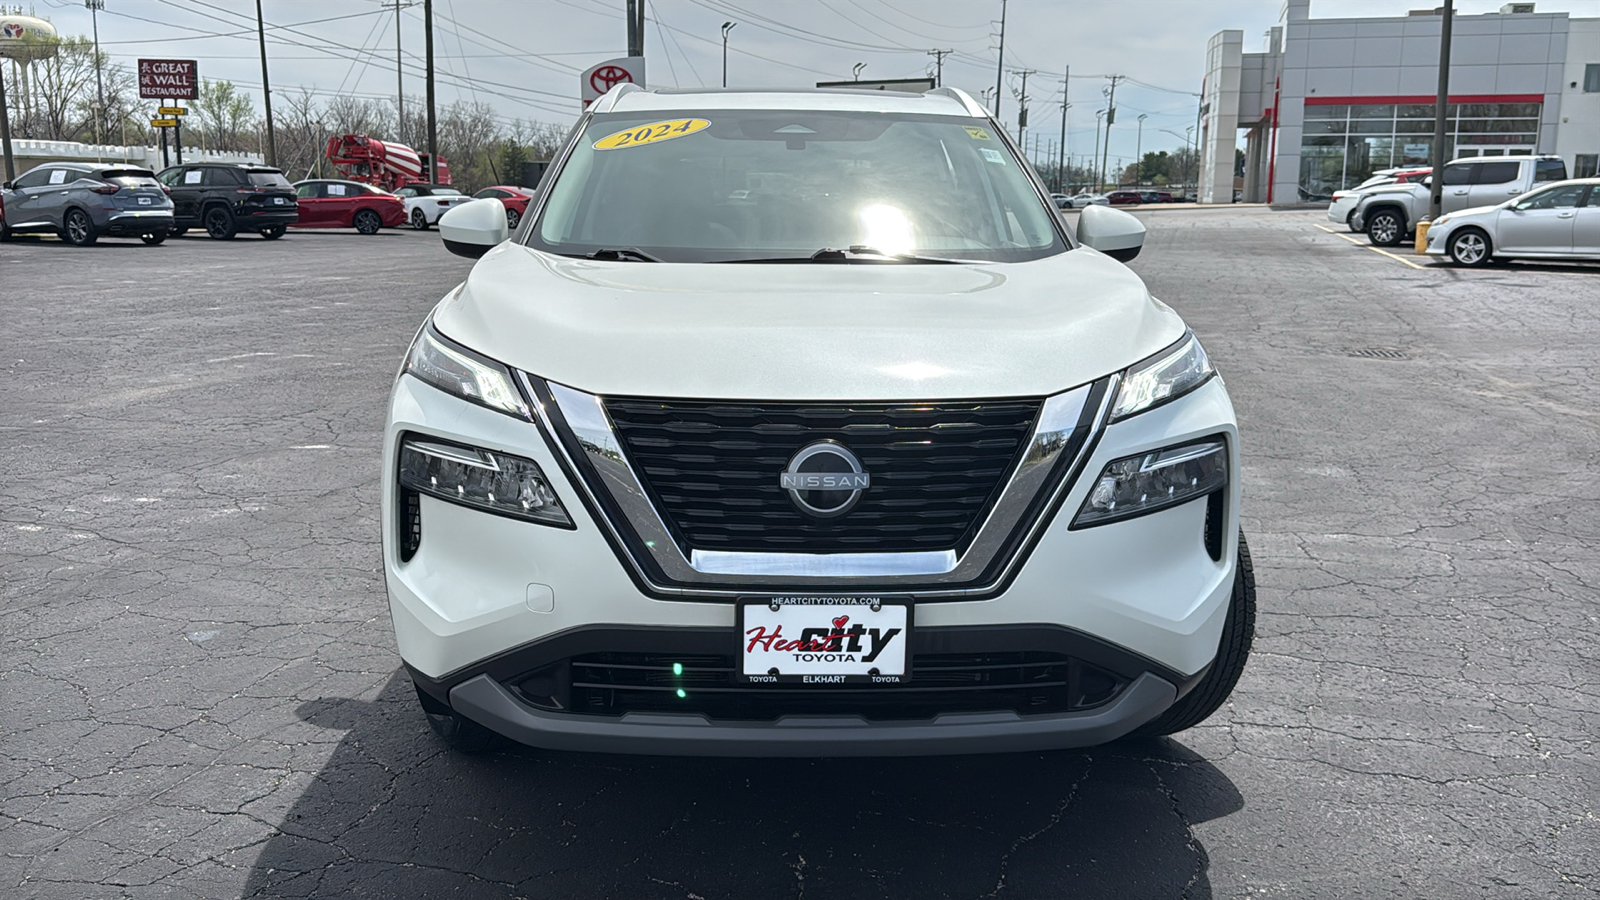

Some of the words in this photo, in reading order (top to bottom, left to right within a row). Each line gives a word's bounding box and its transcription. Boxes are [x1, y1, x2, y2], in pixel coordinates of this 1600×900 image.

[152, 62, 190, 73] GREAT
[153, 75, 189, 85] WALL
[613, 119, 693, 147] 2024
[783, 476, 867, 487] NISSAN
[771, 597, 880, 605] HEARTCITYTOYOTA.COM
[746, 624, 855, 653] Heart
[792, 653, 856, 662] TOYOTA
[749, 675, 777, 683] TOYOTA
[802, 675, 846, 683] ELKHART
